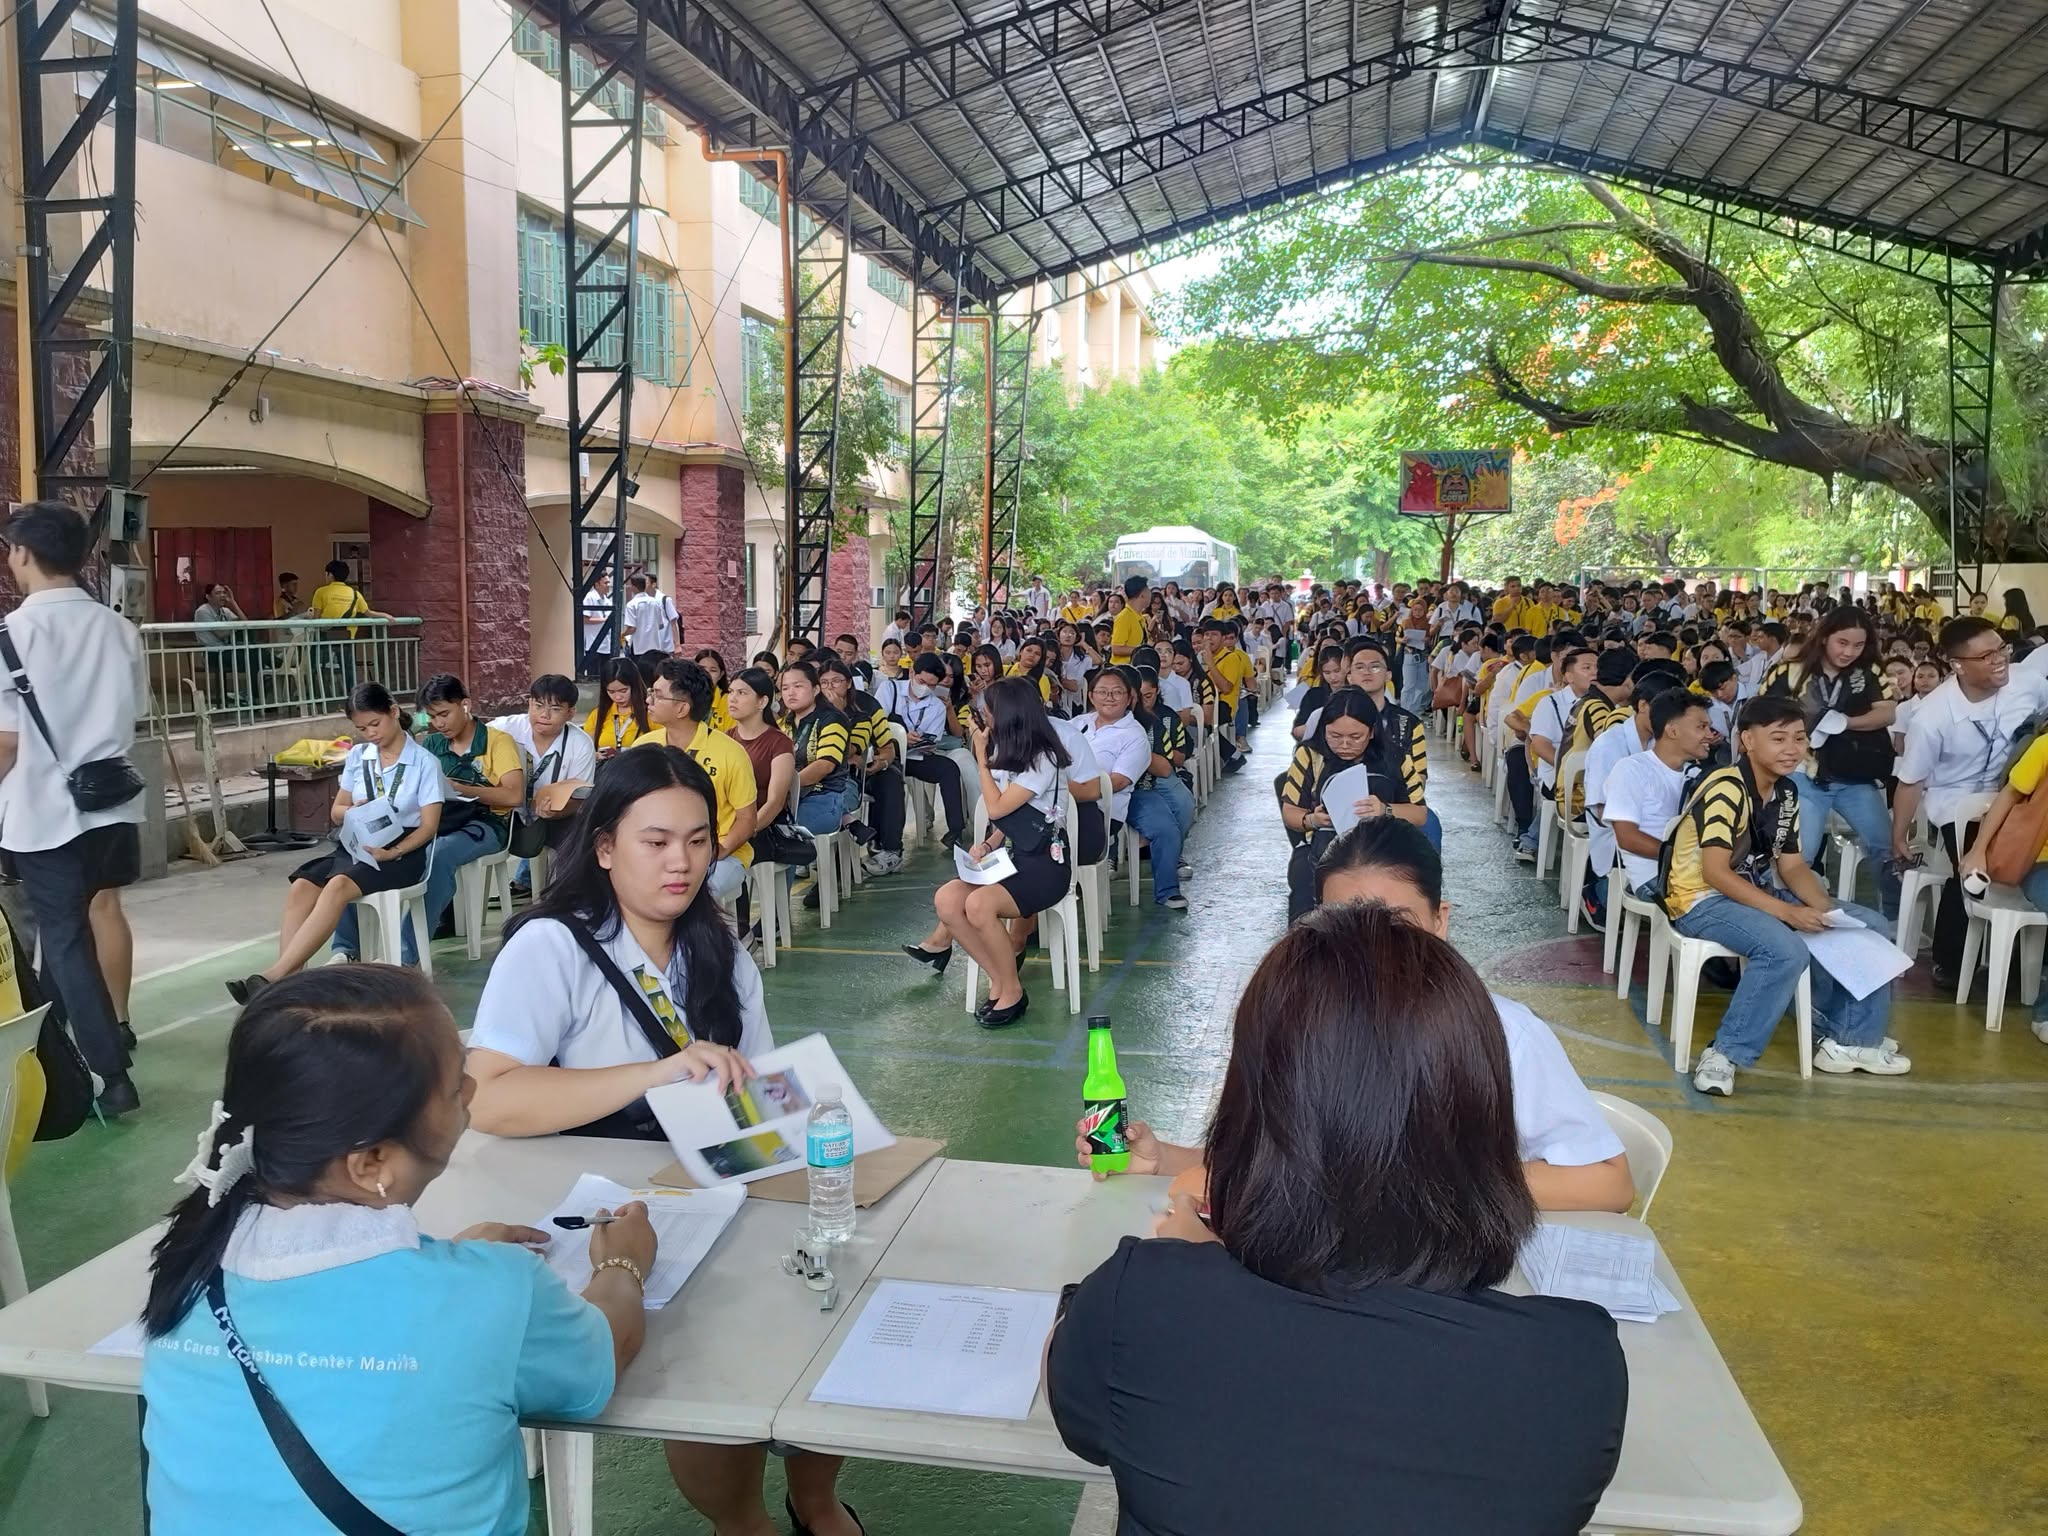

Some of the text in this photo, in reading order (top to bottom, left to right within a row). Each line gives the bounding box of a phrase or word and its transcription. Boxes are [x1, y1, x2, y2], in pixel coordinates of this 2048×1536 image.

[1181, 547, 1207, 559] Manila
[184, 1339, 220, 1357] Cares
[297, 1351, 354, 1369] Center
[360, 1354, 418, 1371] Manila
